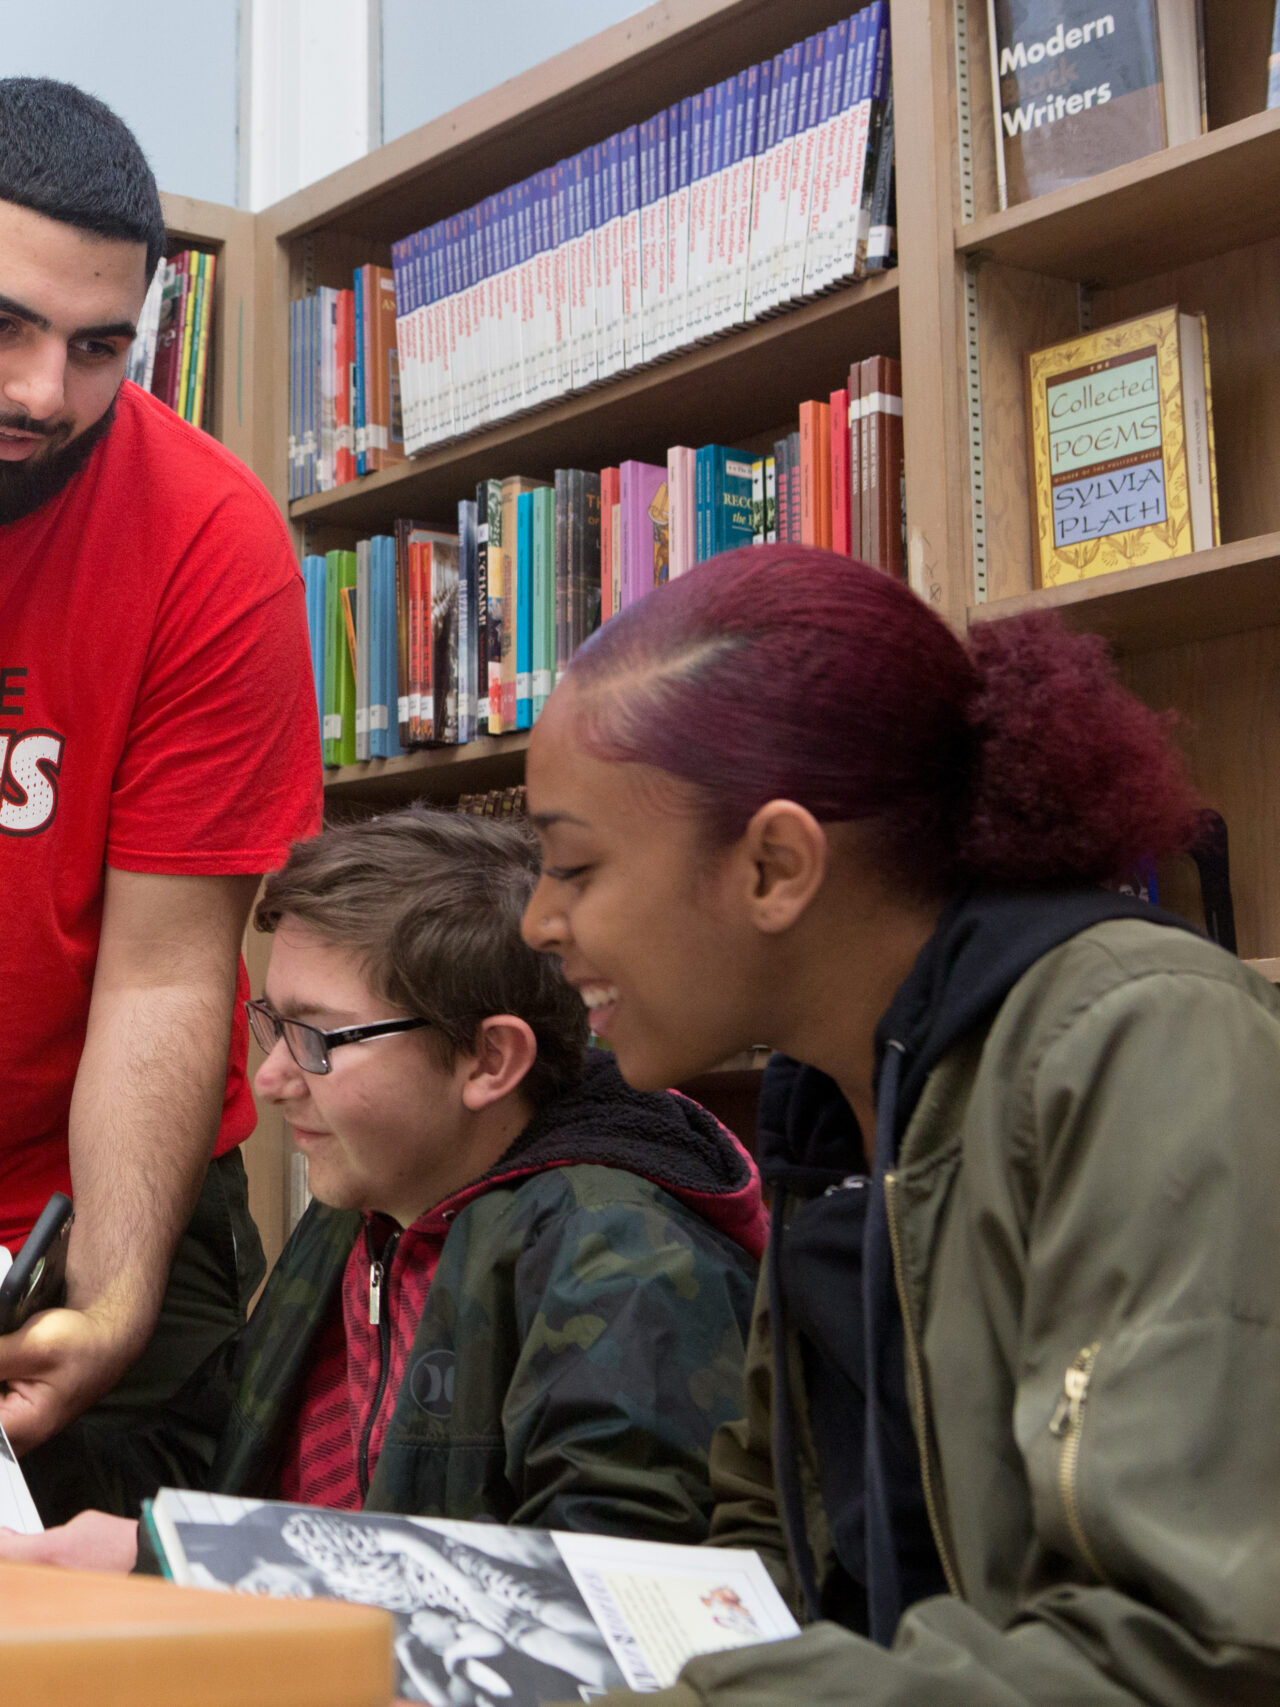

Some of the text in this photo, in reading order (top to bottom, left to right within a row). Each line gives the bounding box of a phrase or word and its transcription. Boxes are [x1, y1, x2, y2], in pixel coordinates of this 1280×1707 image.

[1000, 14, 1115, 76] Modern
[1003, 82, 1112, 137] Writers
[1089, 362, 1110, 372] THE
[1051, 366, 1155, 418] Collected
[1053, 416, 1158, 463] POEMS
[1055, 469, 1161, 511] SYLVIA
[1058, 498, 1160, 538] PLATH
